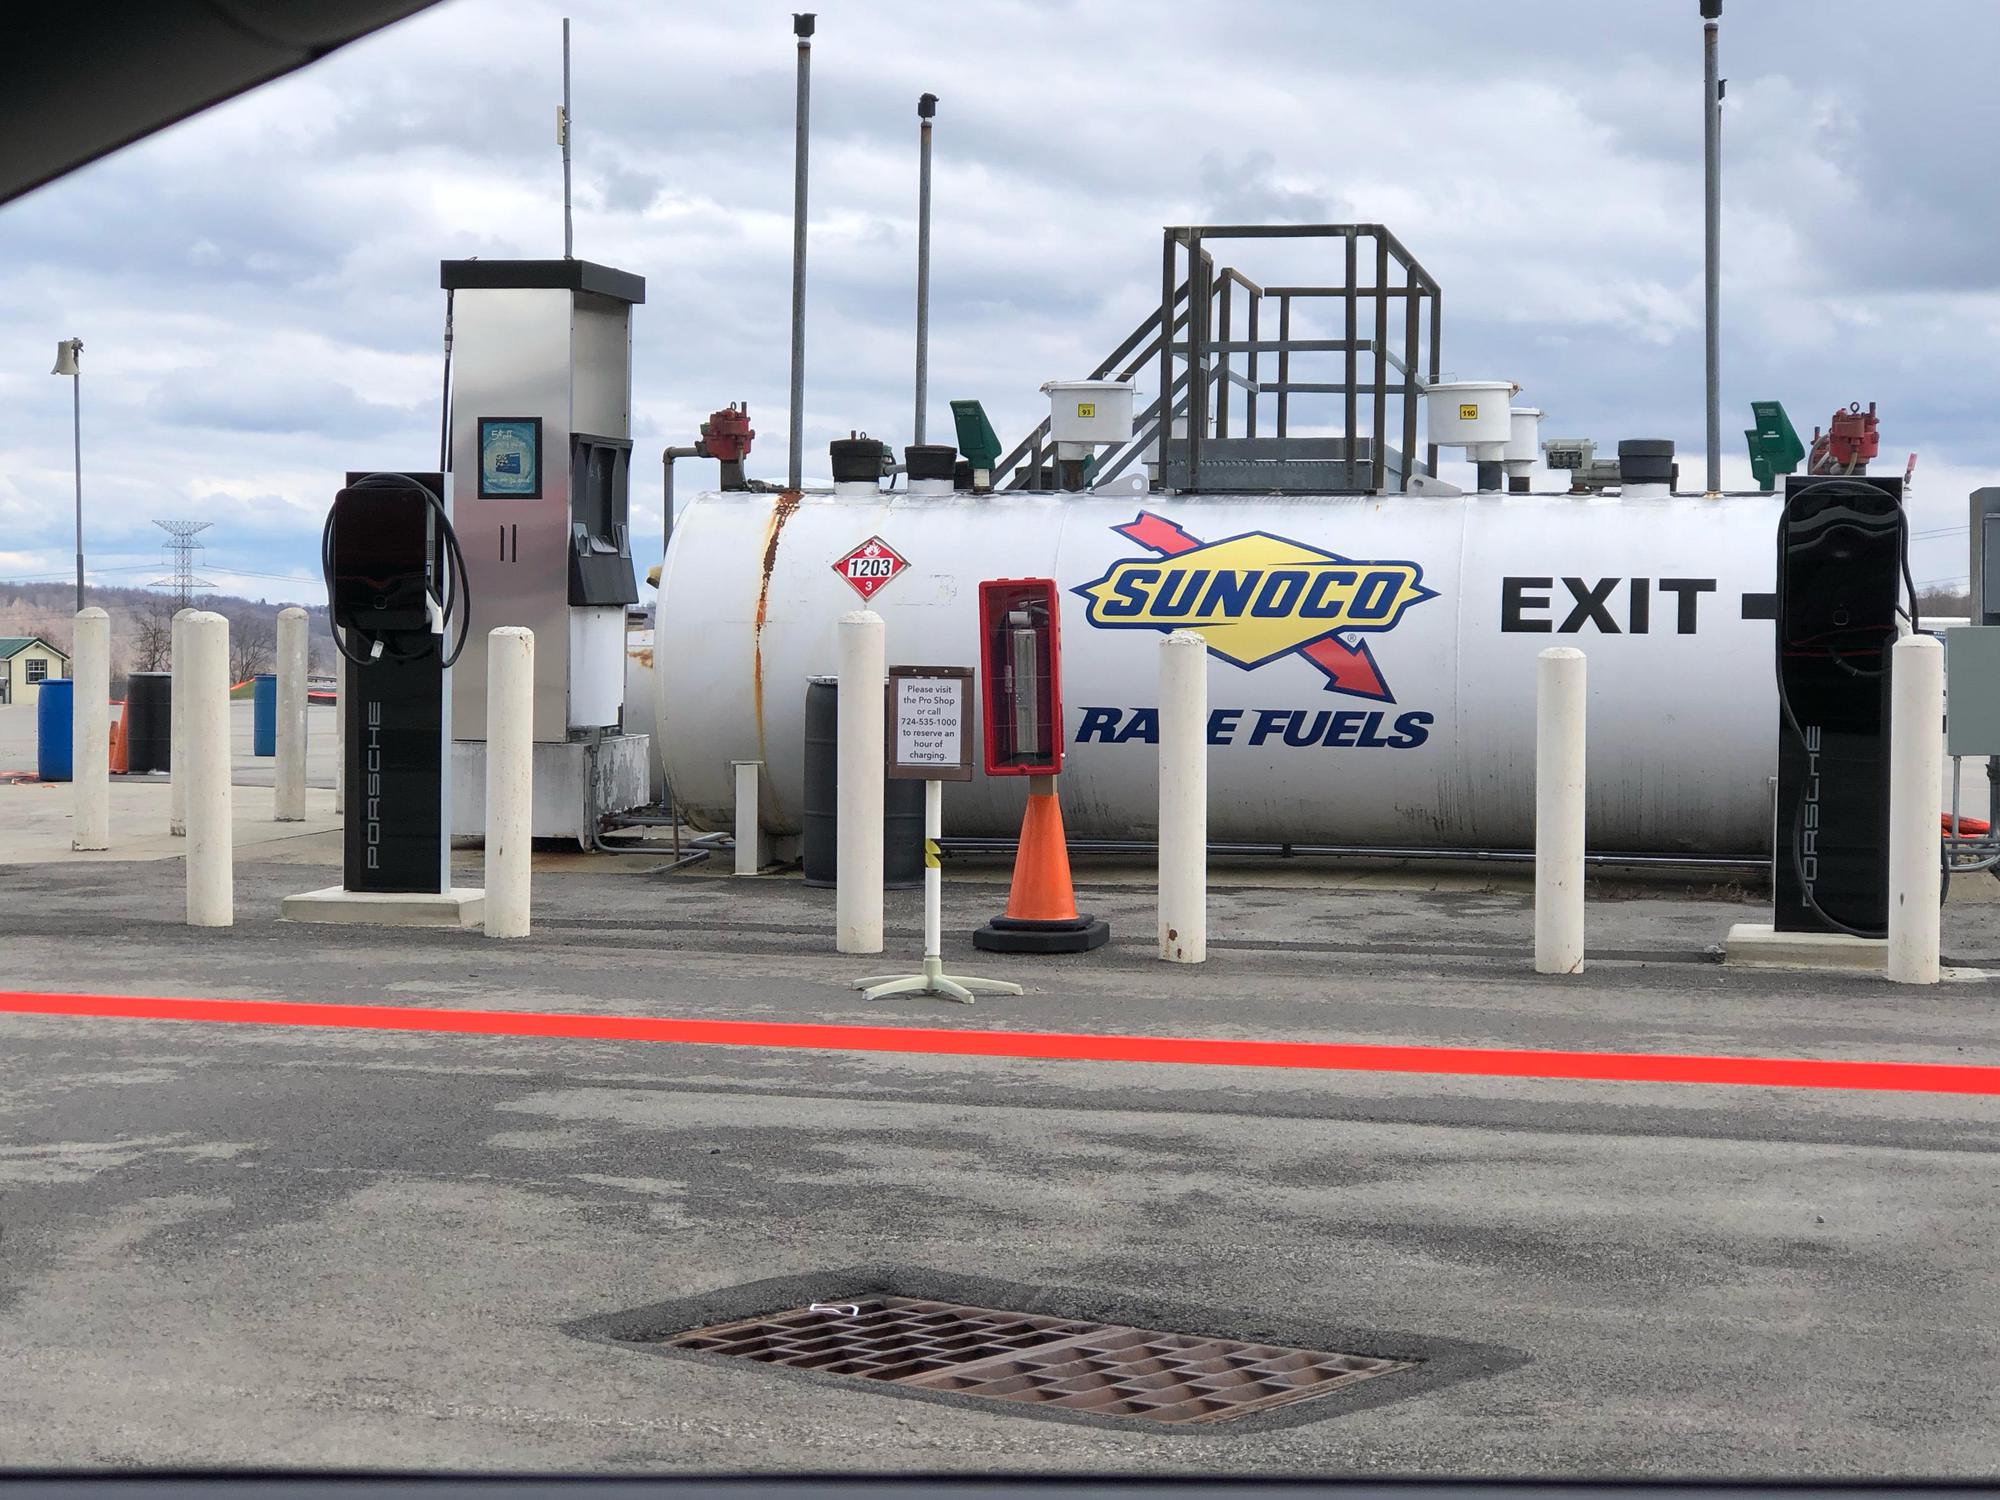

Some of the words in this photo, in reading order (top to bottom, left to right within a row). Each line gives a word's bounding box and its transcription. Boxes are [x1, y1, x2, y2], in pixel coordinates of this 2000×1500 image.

[851, 559, 891, 577] 1203
[864, 581, 873, 591] 3
[1102, 569, 1407, 620] SUNOCO
[1501, 576, 1717, 634] EXIT
[907, 685, 934, 694] Please
[935, 685, 952, 694] visit
[903, 696, 917, 704] the
[918, 696, 932, 704] Pro
[934, 696, 956, 707] Shop
[901, 717, 957, 726] 724-535-1000
[1074, 706, 1245, 746] RAE
[1248, 709, 1435, 749] FUELS
[913, 740, 933, 748] hour
[934, 740, 943, 748] of
[909, 751, 948, 761] charging.
[367, 701, 381, 869] PORSCHE
